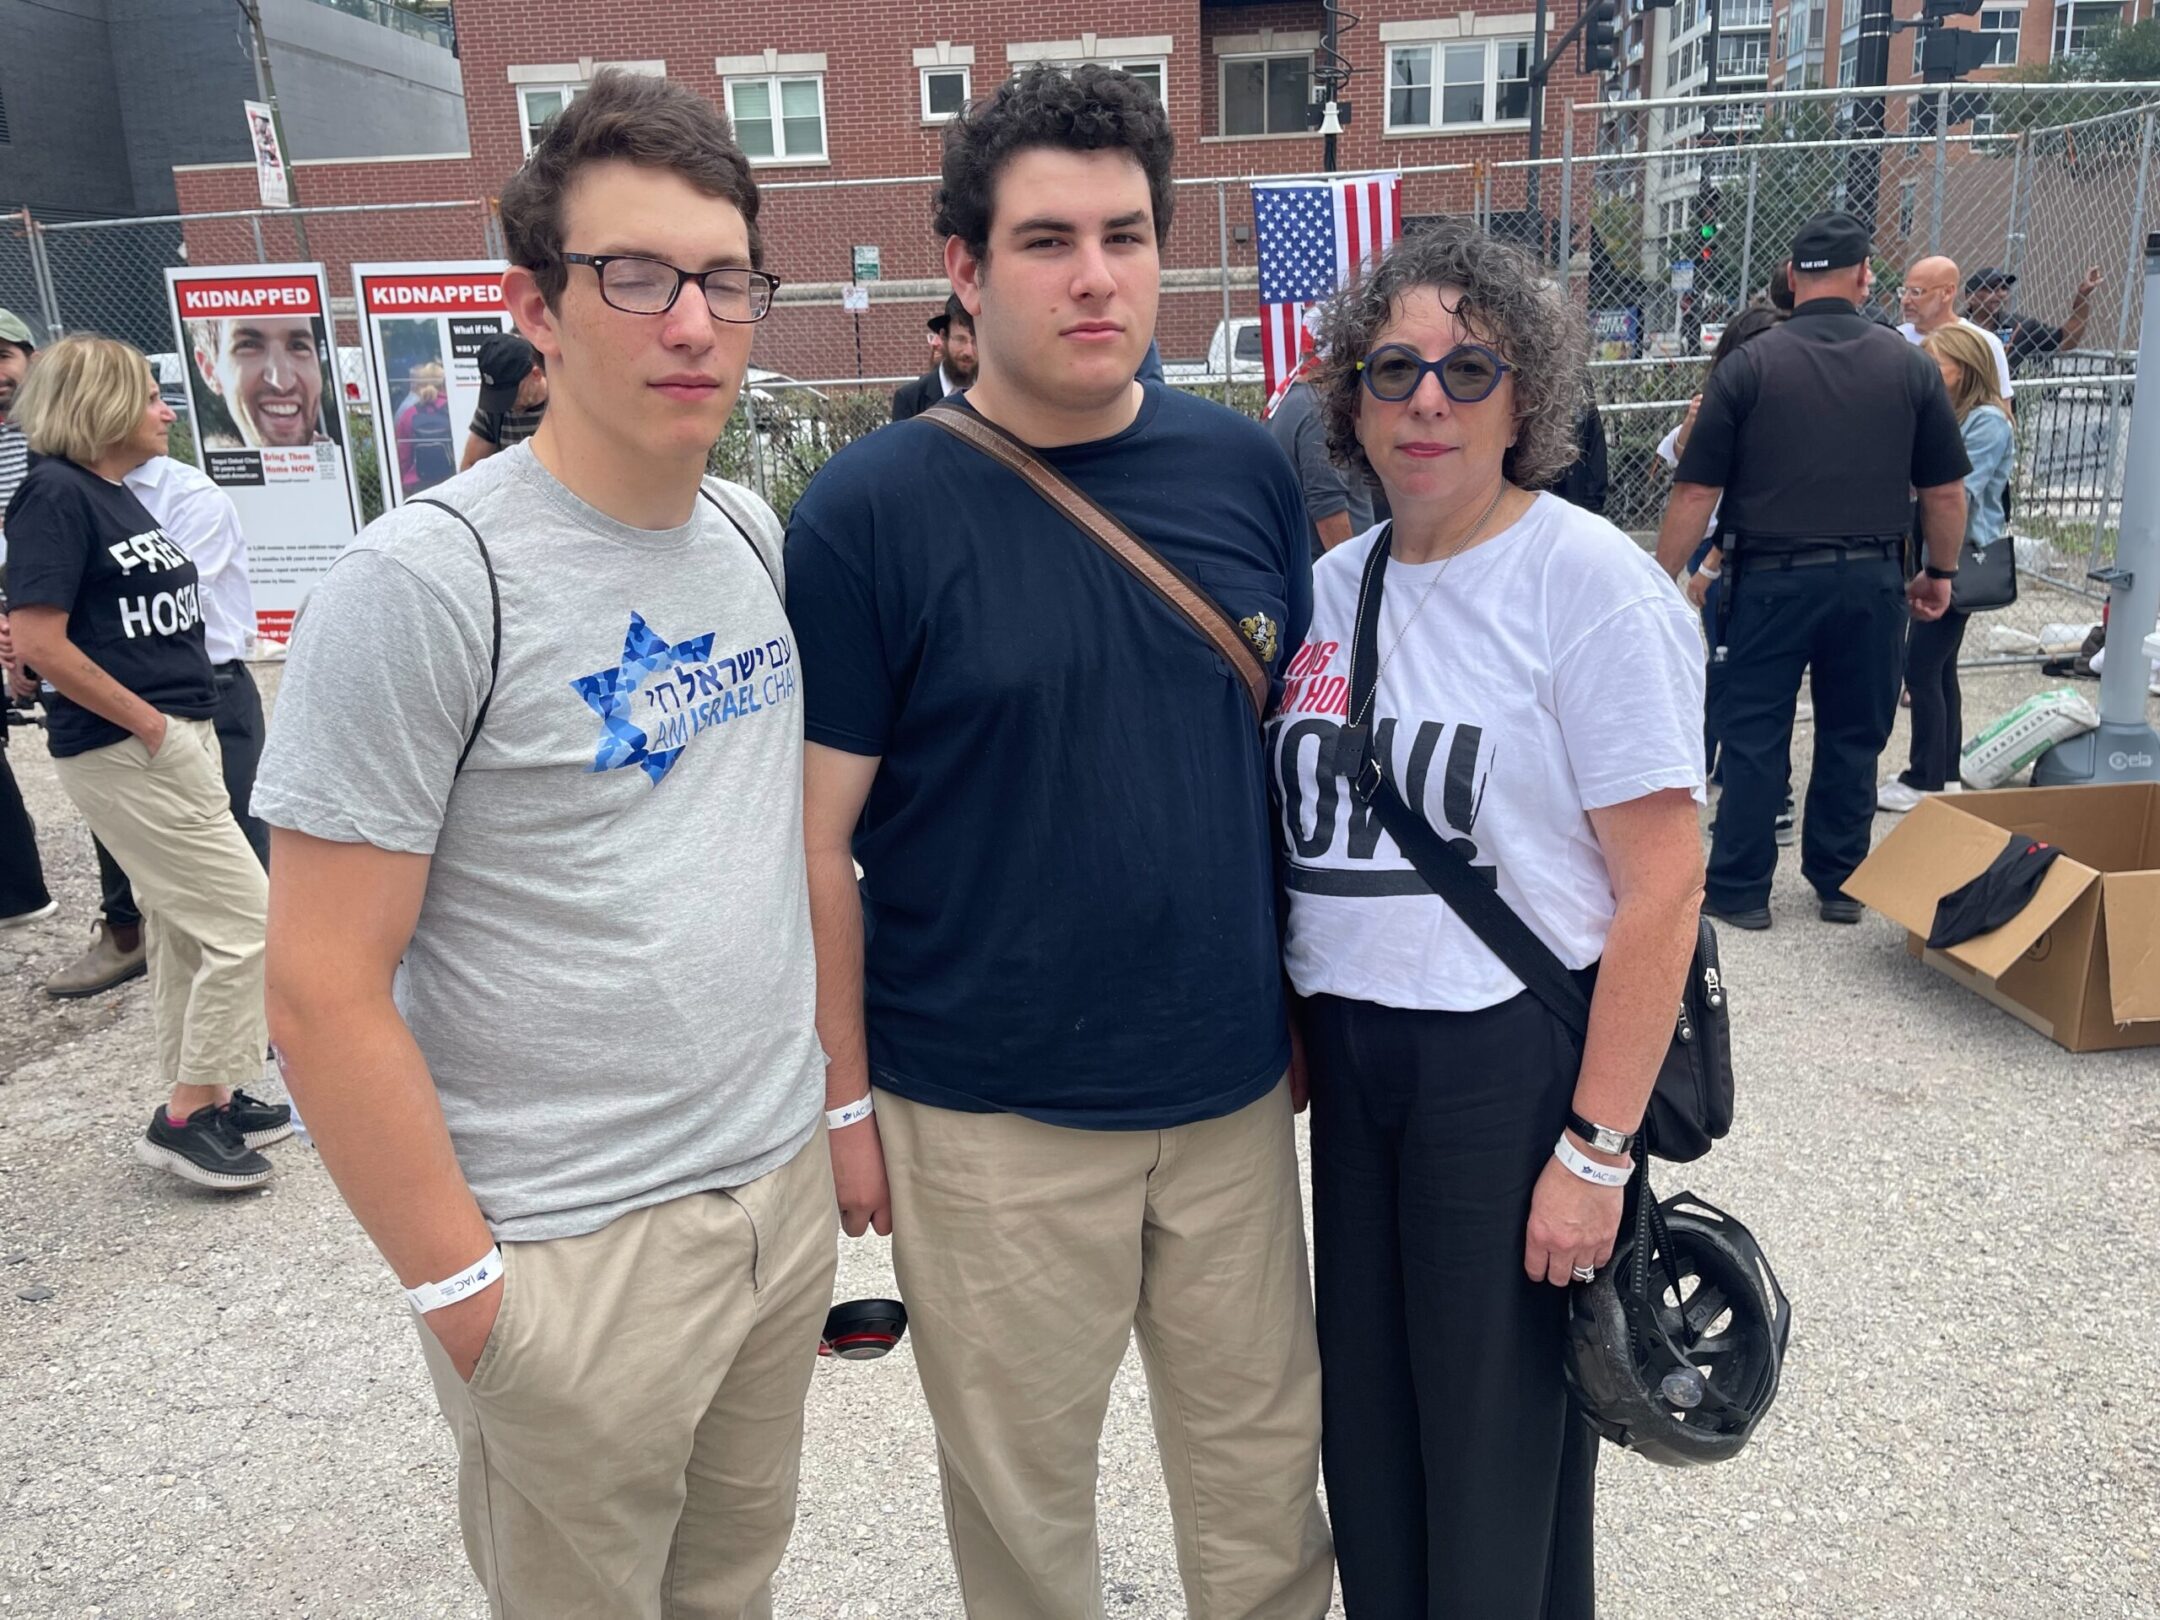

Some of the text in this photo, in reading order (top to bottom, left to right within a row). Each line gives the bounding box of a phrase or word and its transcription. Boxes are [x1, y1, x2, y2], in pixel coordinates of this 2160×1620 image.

[185, 287, 311, 309] KIDNAPPED
[372, 284, 503, 305] KIDNAPPED
[453, 324, 498, 335] What if this
[264, 452, 310, 462] Bring Them
[265, 465, 289, 473] Home
[118, 583, 205, 638] HOSTA
[1287, 640, 1339, 676] ING
[645, 634, 791, 713] עם ישראל חי
[1297, 675, 1348, 716] HO
[652, 712, 689, 751] AM
[689, 683, 762, 737] ISRAEL
[852, 1106, 866, 1118] IAC
[1592, 1171, 1609, 1181] IAC
[454, 1274, 476, 1292] IAC
